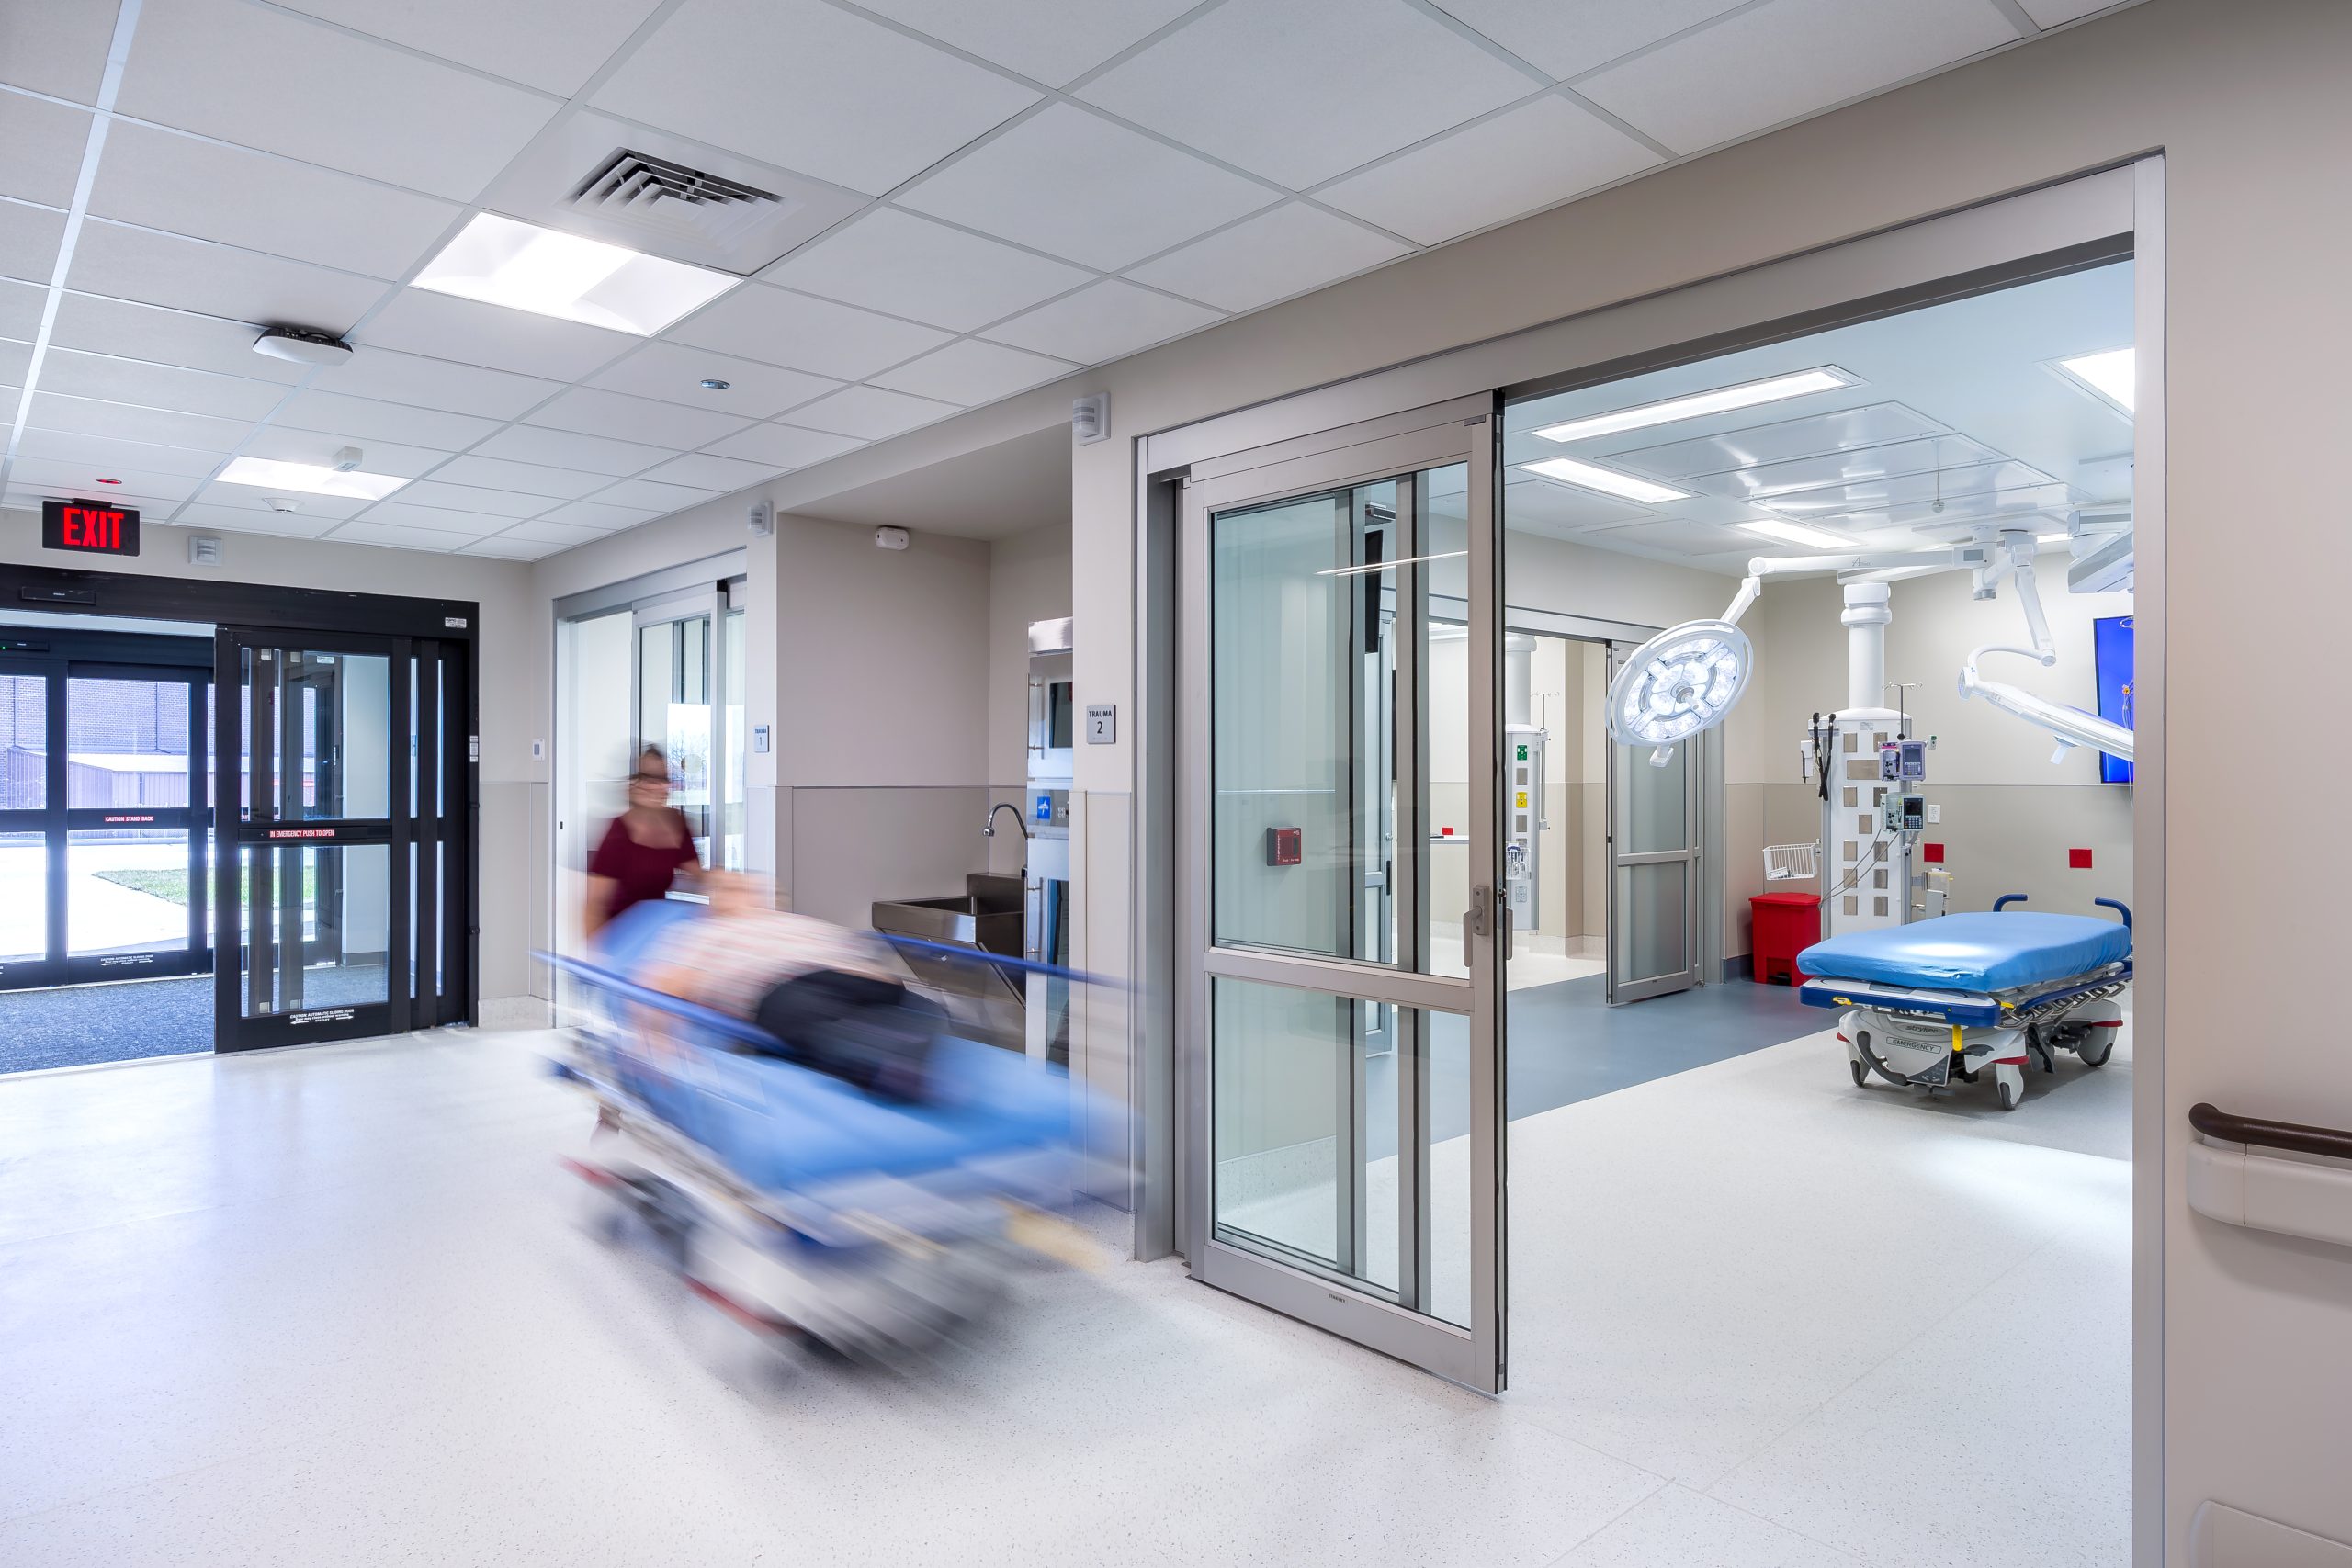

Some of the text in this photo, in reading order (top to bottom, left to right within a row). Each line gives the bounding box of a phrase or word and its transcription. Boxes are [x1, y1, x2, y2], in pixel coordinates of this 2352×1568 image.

[64, 507, 124, 549] EXIT
[1097, 721, 1103, 734] 2
[1893, 1039, 1935, 1051] EMERGENCY
